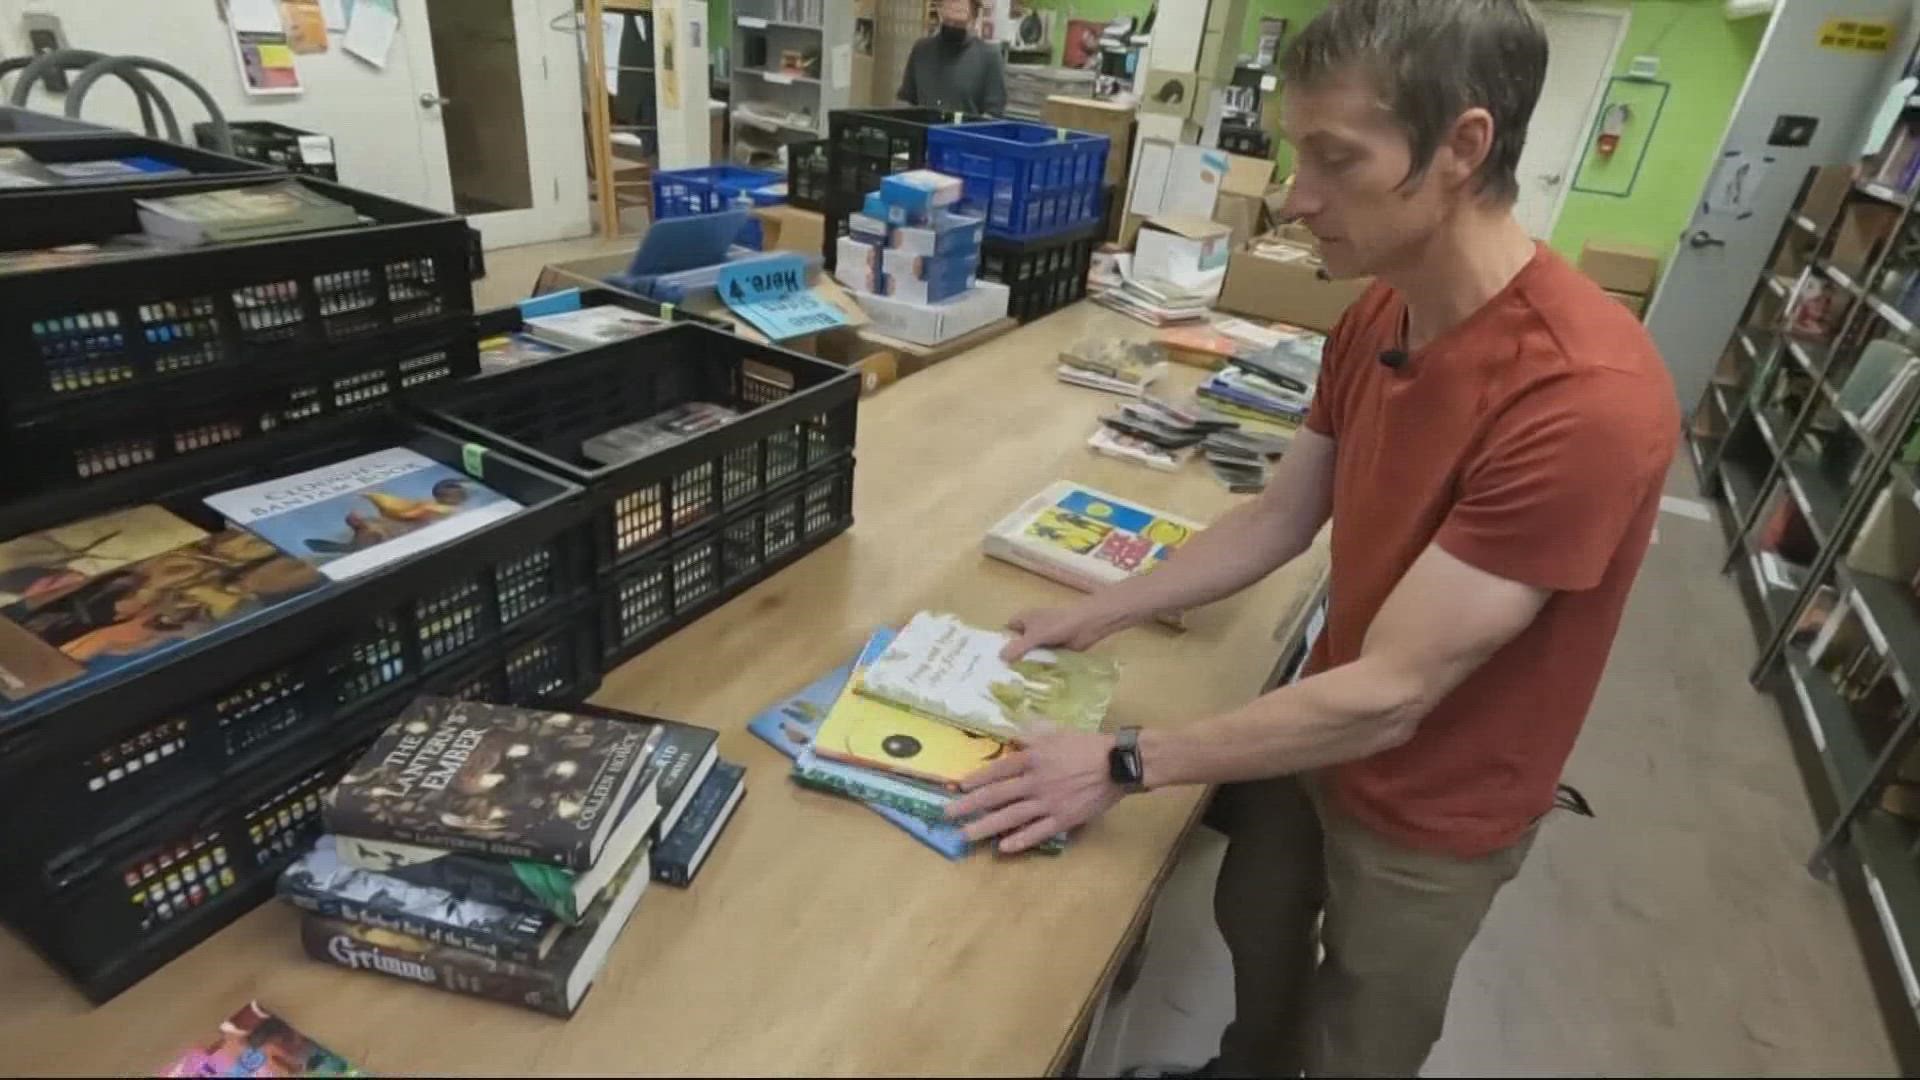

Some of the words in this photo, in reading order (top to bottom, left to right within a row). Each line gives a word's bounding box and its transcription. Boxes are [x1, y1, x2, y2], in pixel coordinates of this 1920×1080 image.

[745, 268, 800, 293] Here.
[383, 735, 424, 767] THE
[419, 729, 489, 791] EMBER
